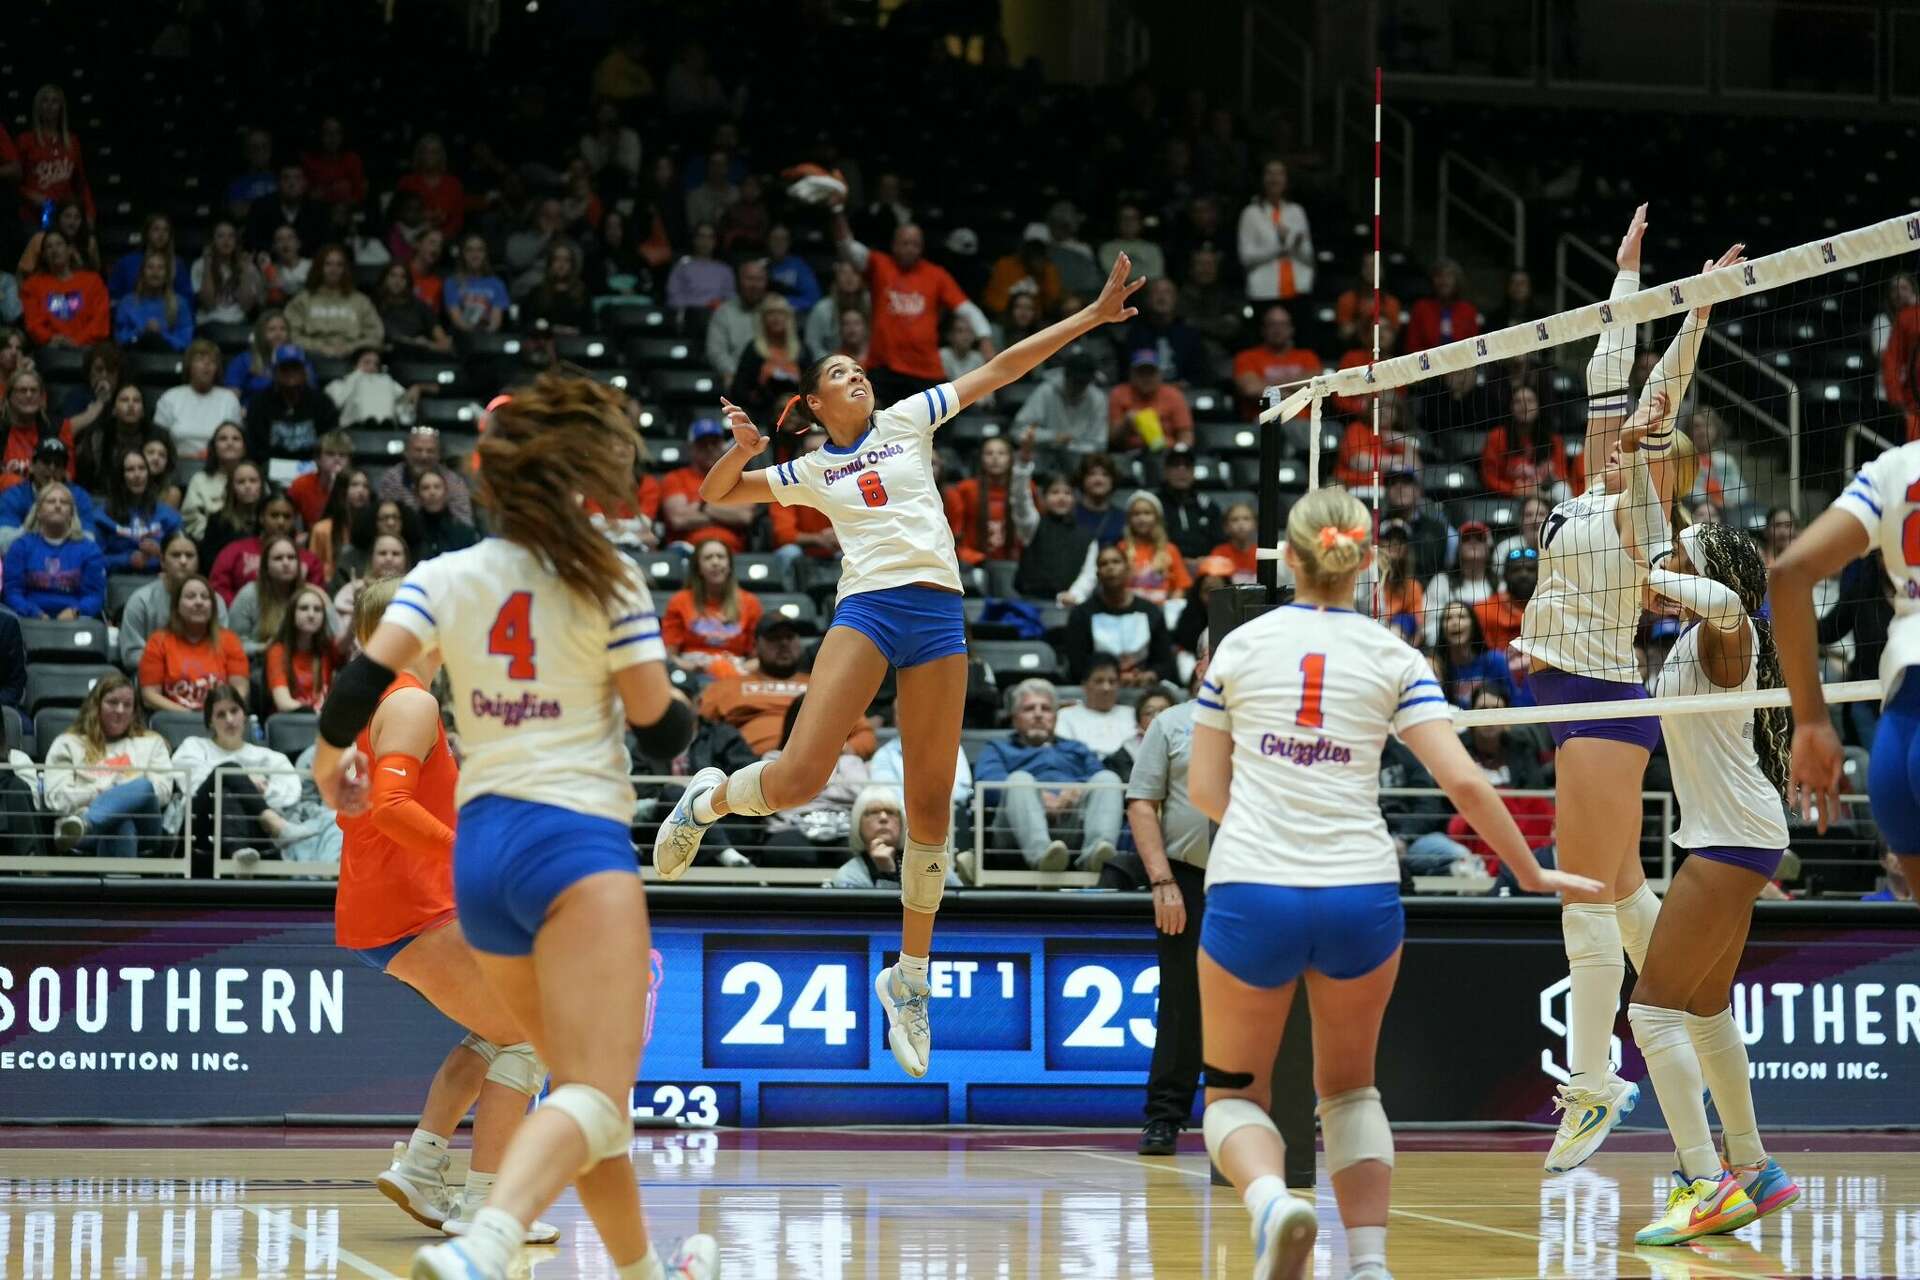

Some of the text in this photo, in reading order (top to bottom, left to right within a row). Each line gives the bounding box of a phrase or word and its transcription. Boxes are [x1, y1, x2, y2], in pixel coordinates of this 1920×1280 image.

[823, 444, 904, 487] Grand Oaks
[856, 470, 889, 508] 8
[487, 590, 536, 681] 4
[472, 688, 562, 726] Grizzlies
[1295, 652, 1326, 729] 1
[1261, 733, 1351, 767] Grizzlies
[930, 961, 1014, 999] ET 1
[720, 961, 857, 1045] 24
[1732, 983, 1920, 1045] UTHER
[0, 1050, 249, 1071] ECOGNITION INC.
[1837, 1062, 1889, 1080] INC.
